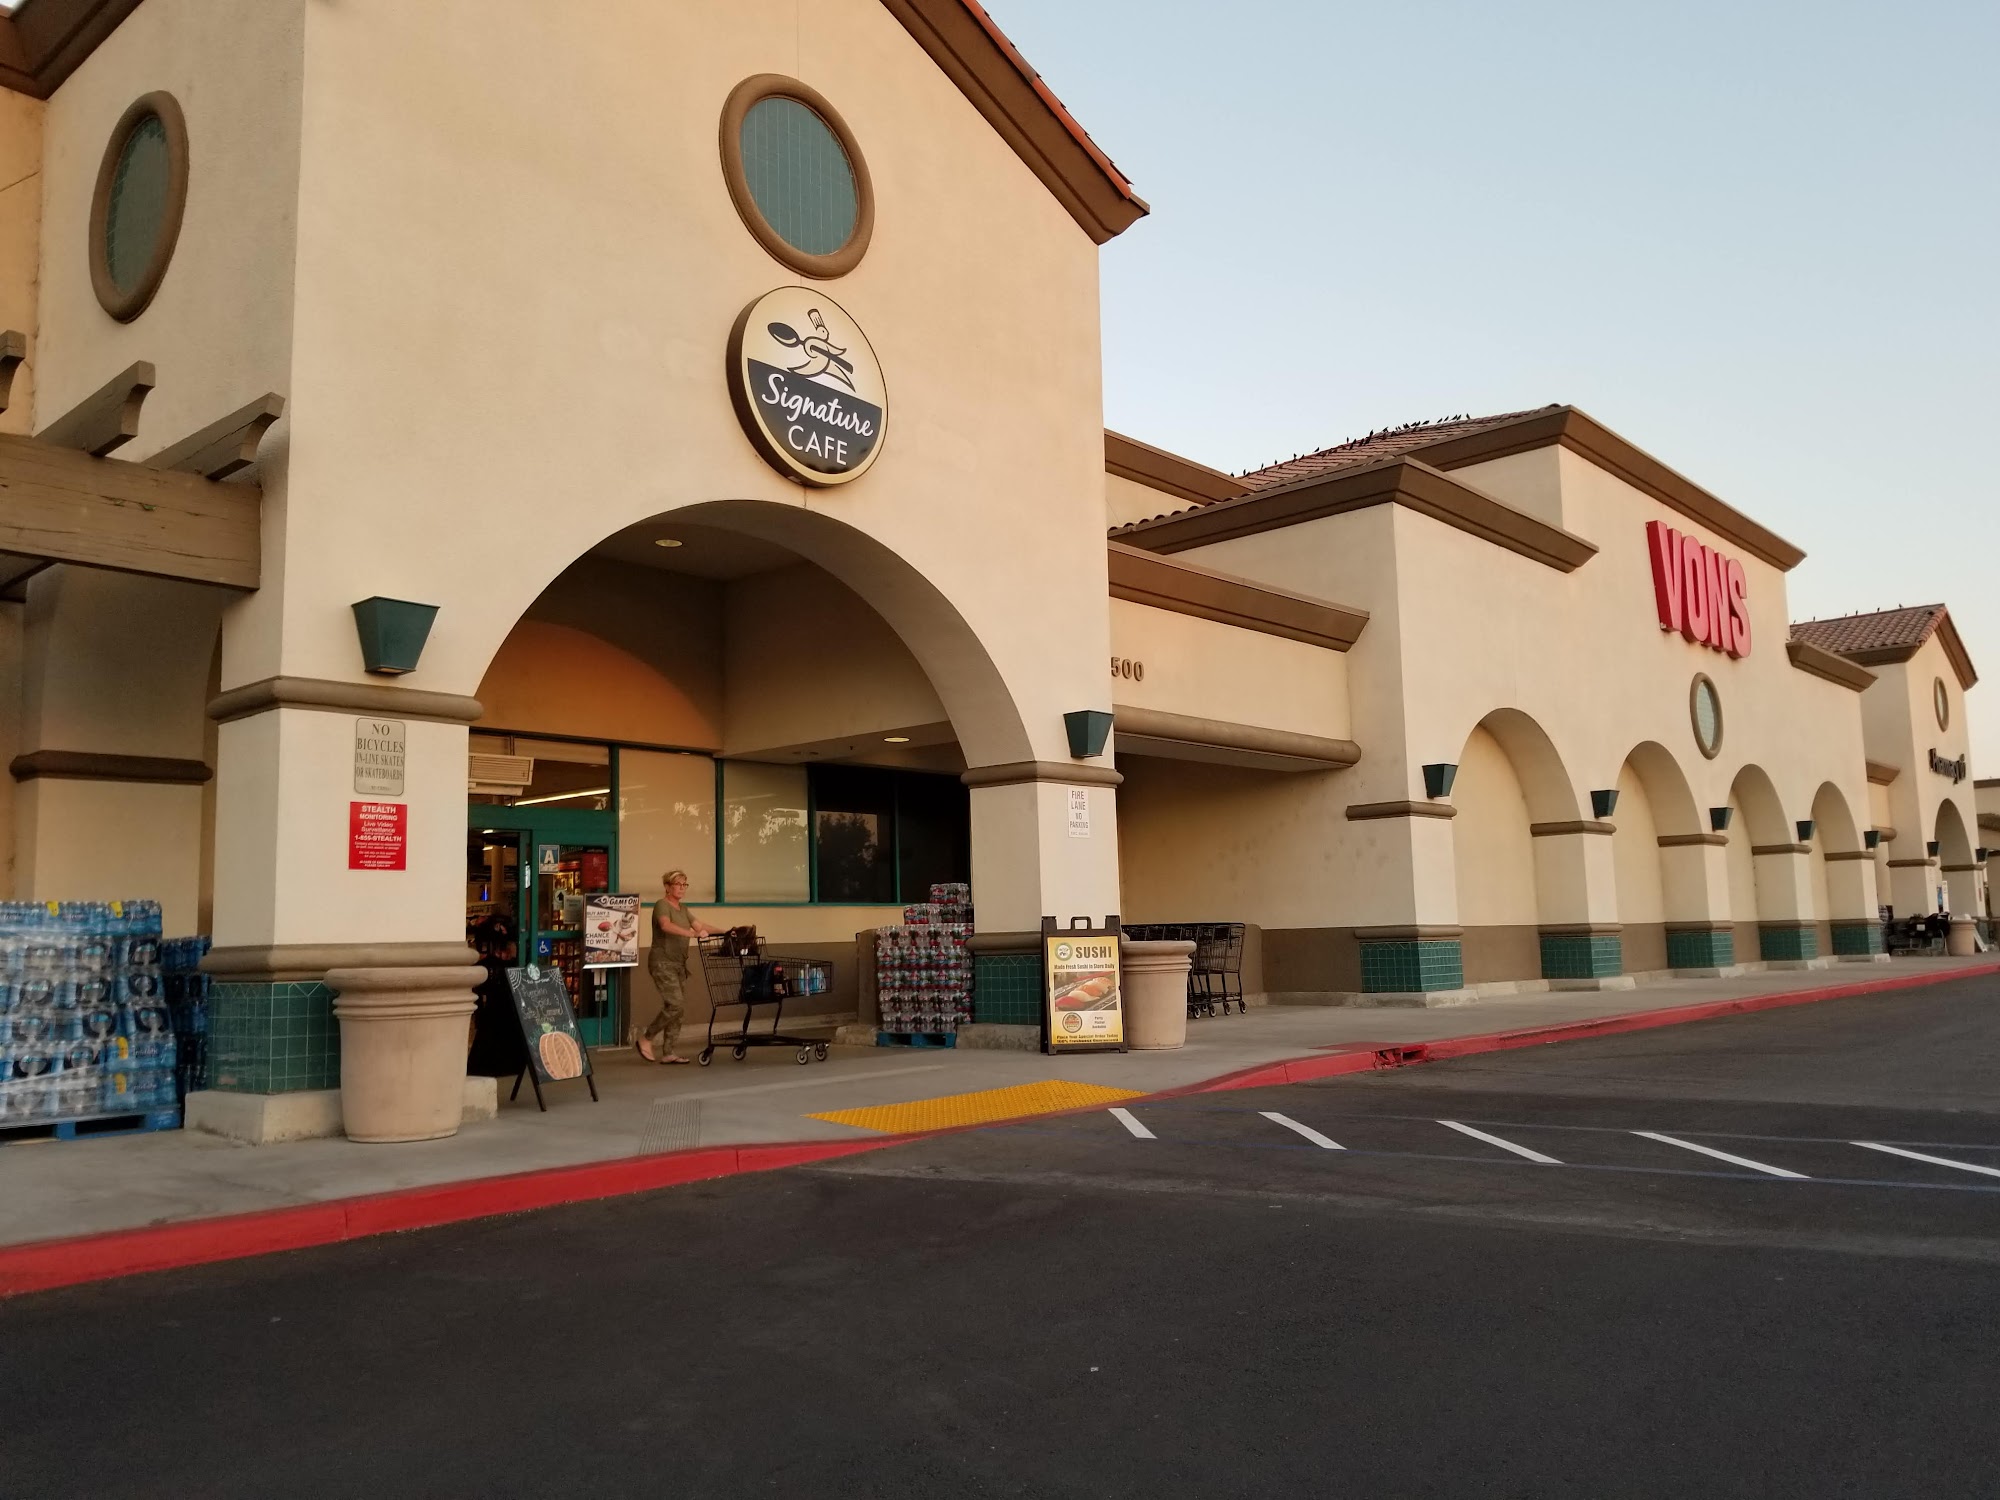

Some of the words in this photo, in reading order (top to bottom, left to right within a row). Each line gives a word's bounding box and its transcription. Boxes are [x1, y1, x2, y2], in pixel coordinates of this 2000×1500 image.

[762, 373, 873, 438] Signature
[788, 425, 848, 466] CAFE
[1645, 520, 1752, 659] VONS
[371, 723, 390, 736] NO
[357, 737, 404, 753] BICYCLES
[356, 752, 379, 765] IN-LINE
[380, 754, 404, 767] SKATES
[1071, 790, 1085, 800] FIRE
[361, 805, 397, 814] STEALTH
[1071, 801, 1086, 810] LANE
[359, 813, 398, 821] MONITORING
[1075, 812, 1082, 820] NO
[1070, 820, 1089, 829] PARKING
[543, 849, 555, 864] A
[1075, 946, 1112, 958] SUSHI
